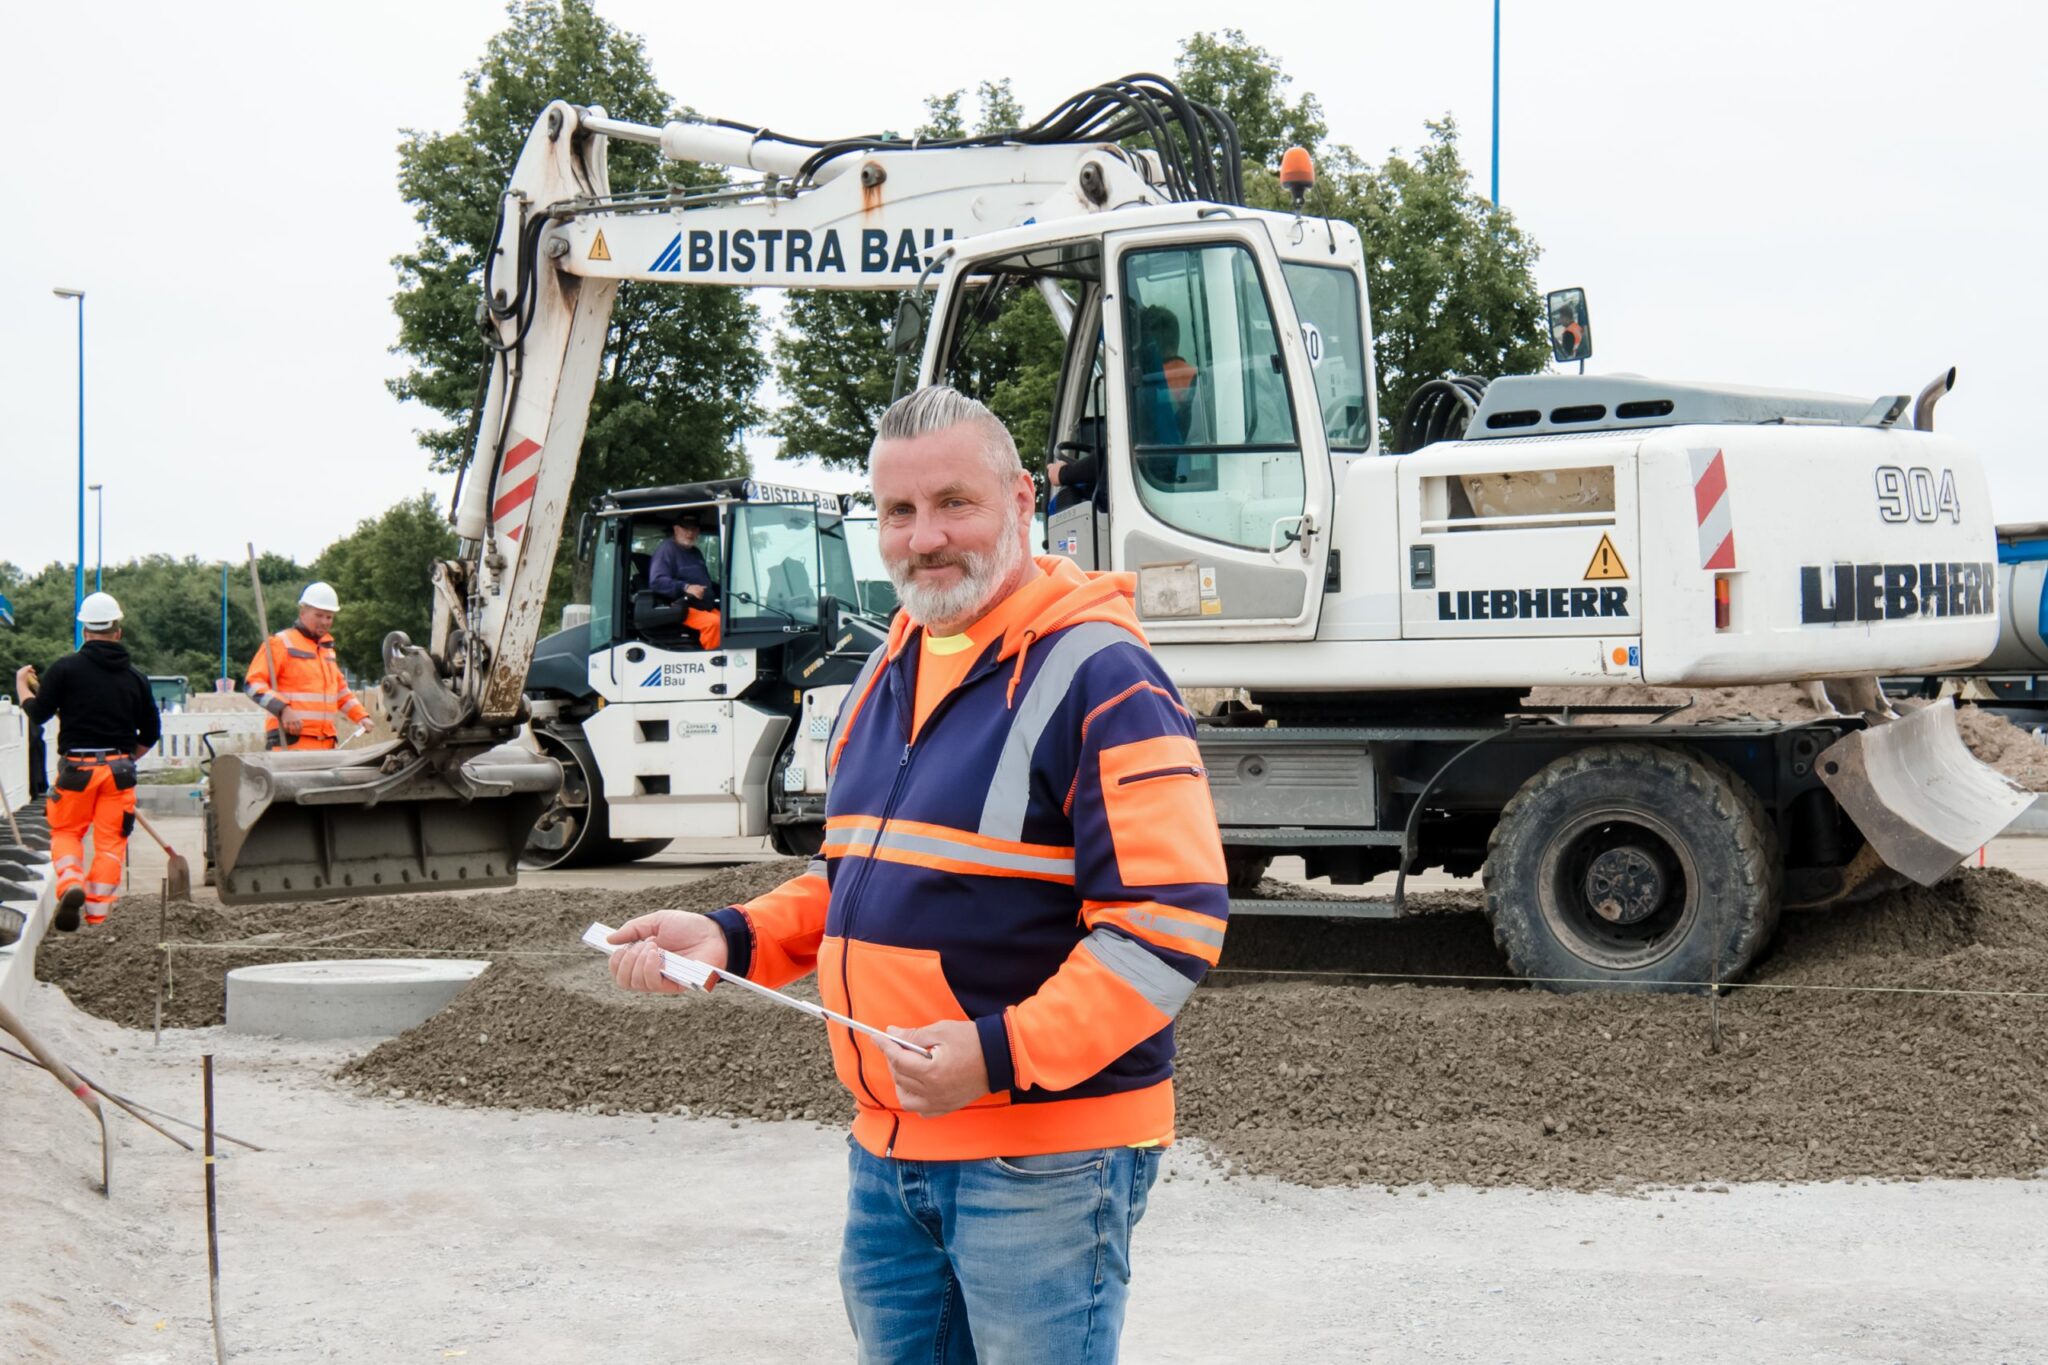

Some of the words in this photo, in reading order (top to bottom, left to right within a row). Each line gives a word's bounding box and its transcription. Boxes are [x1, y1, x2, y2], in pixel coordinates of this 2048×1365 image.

[689, 229, 846, 273] BISTRA
[812, 493, 837, 511] Bau
[1875, 466, 1960, 524] 904
[1438, 586, 1629, 621] LIEBHERR
[1801, 562, 1994, 624] LIEBHERR
[664, 663, 705, 675] BISTRA
[664, 676, 685, 687] Bau
